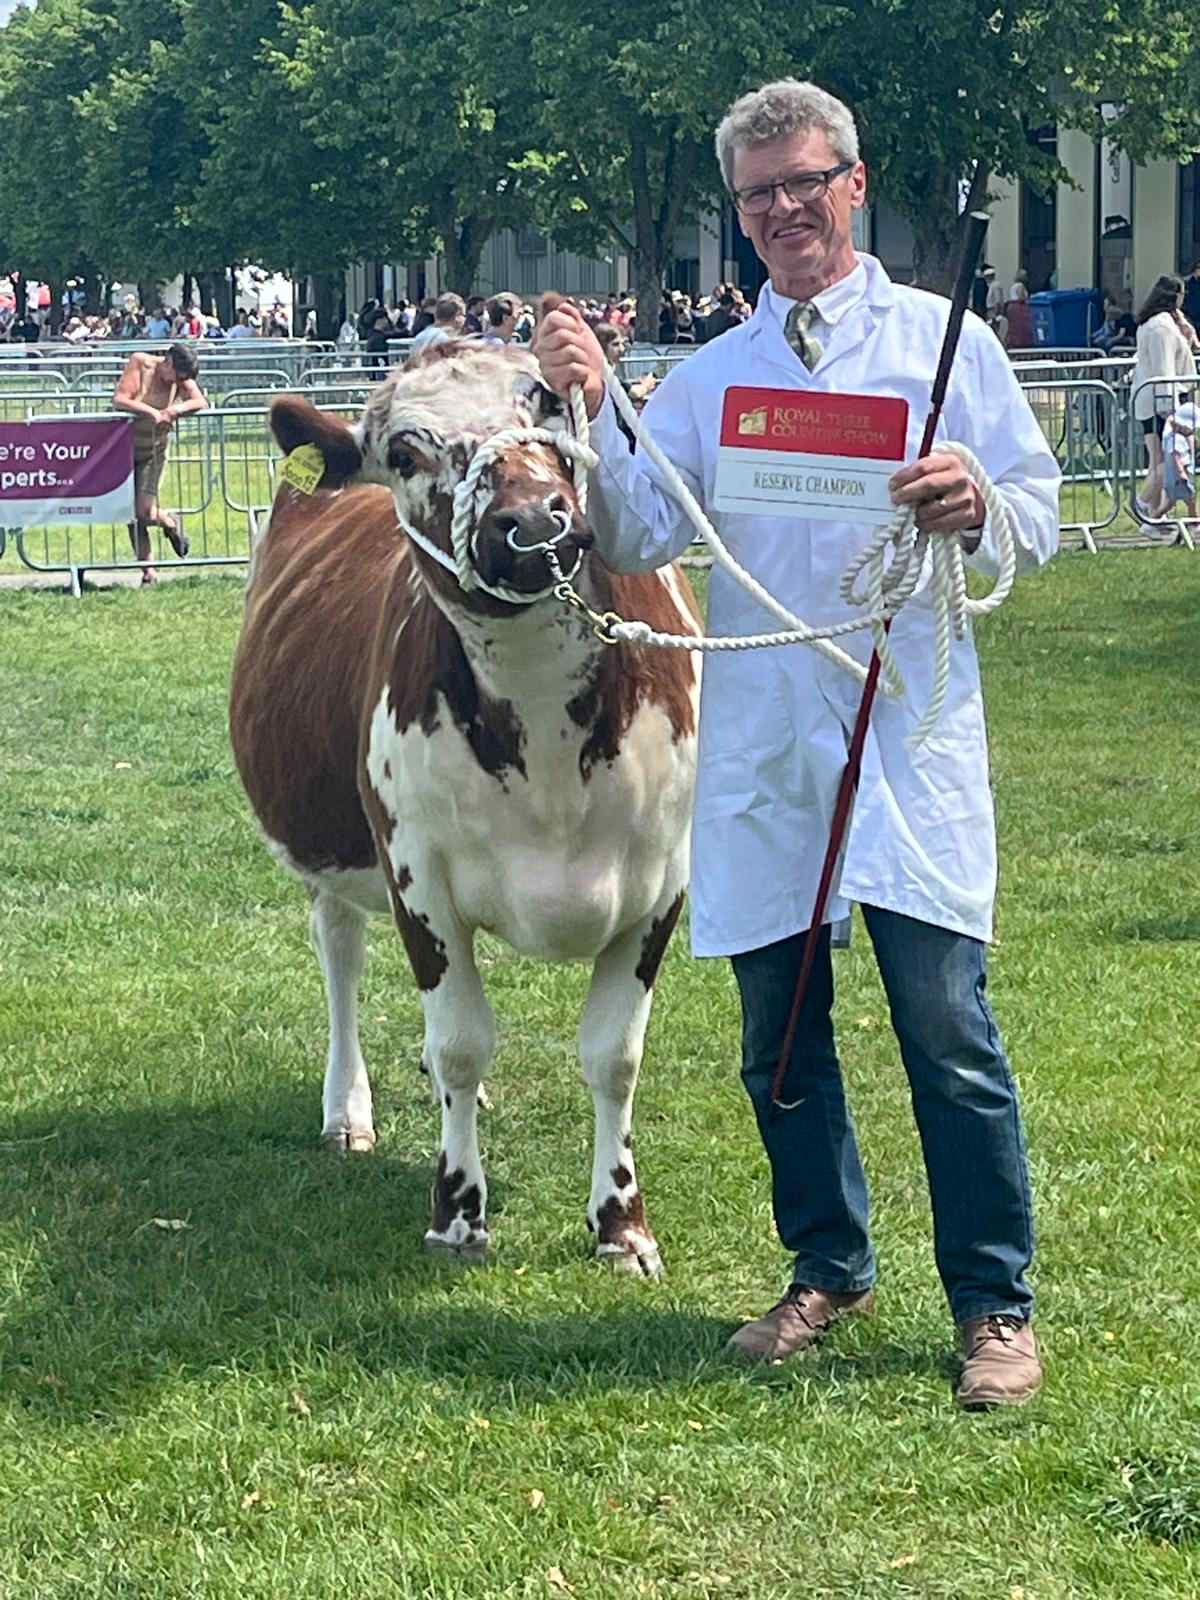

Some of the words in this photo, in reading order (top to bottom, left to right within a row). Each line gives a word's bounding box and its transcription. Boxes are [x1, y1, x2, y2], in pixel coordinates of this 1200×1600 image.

[774, 407, 822, 424] ROYAL
[42, 442, 91, 460] Your
[753, 471, 802, 492] RESERVE
[805, 476, 866, 497] CHAMPION
